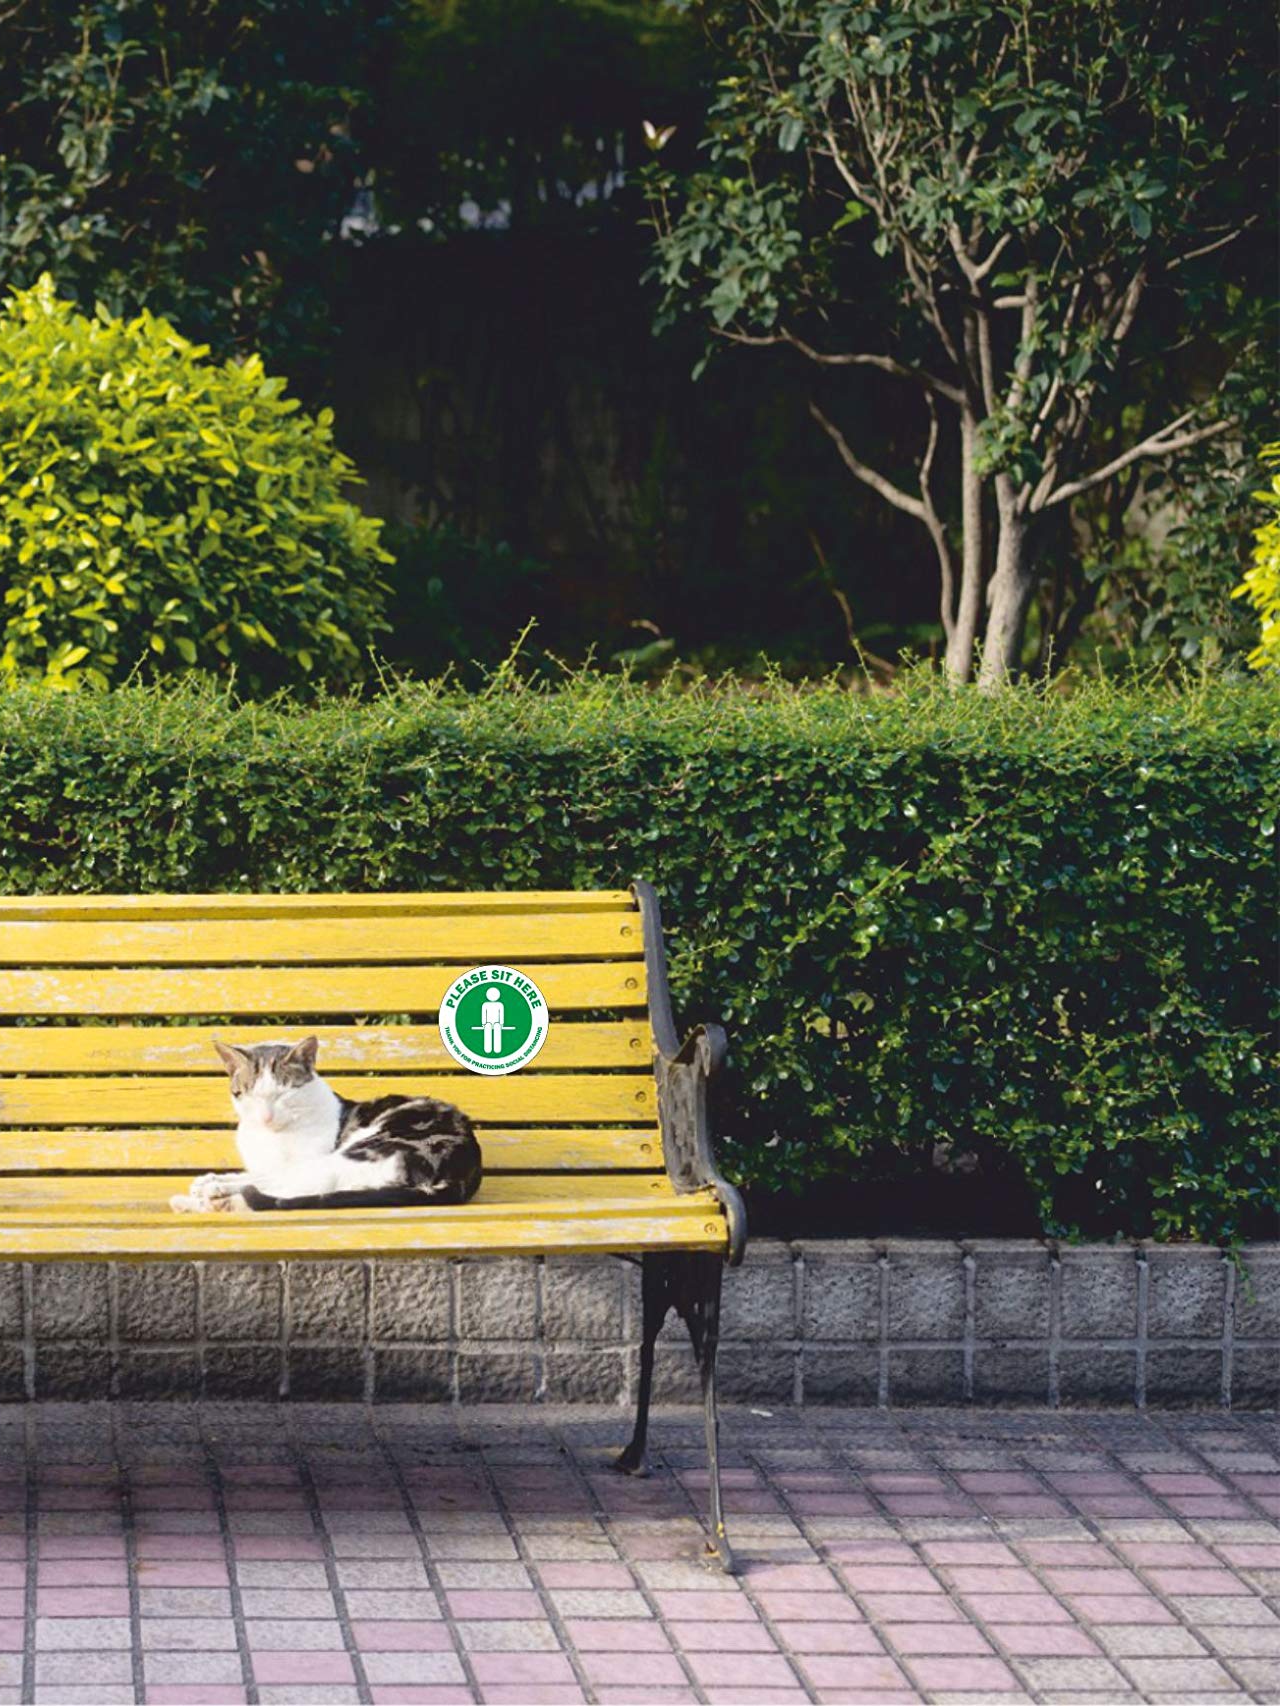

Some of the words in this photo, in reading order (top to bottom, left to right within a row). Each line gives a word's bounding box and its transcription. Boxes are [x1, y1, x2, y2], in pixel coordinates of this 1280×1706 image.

[446, 970, 488, 1009] PLEASE
[491, 969, 513, 982] SIT
[513, 976, 542, 1009] HERE
[444, 1026, 453, 1045] THANK
[452, 1044, 462, 1055] YOU
[461, 1053, 472, 1063] FOR
[471, 1060, 505, 1070] PRACTICING
[505, 1055, 525, 1068] SOCIAL
[524, 1026, 543, 1057] DISTANCING
